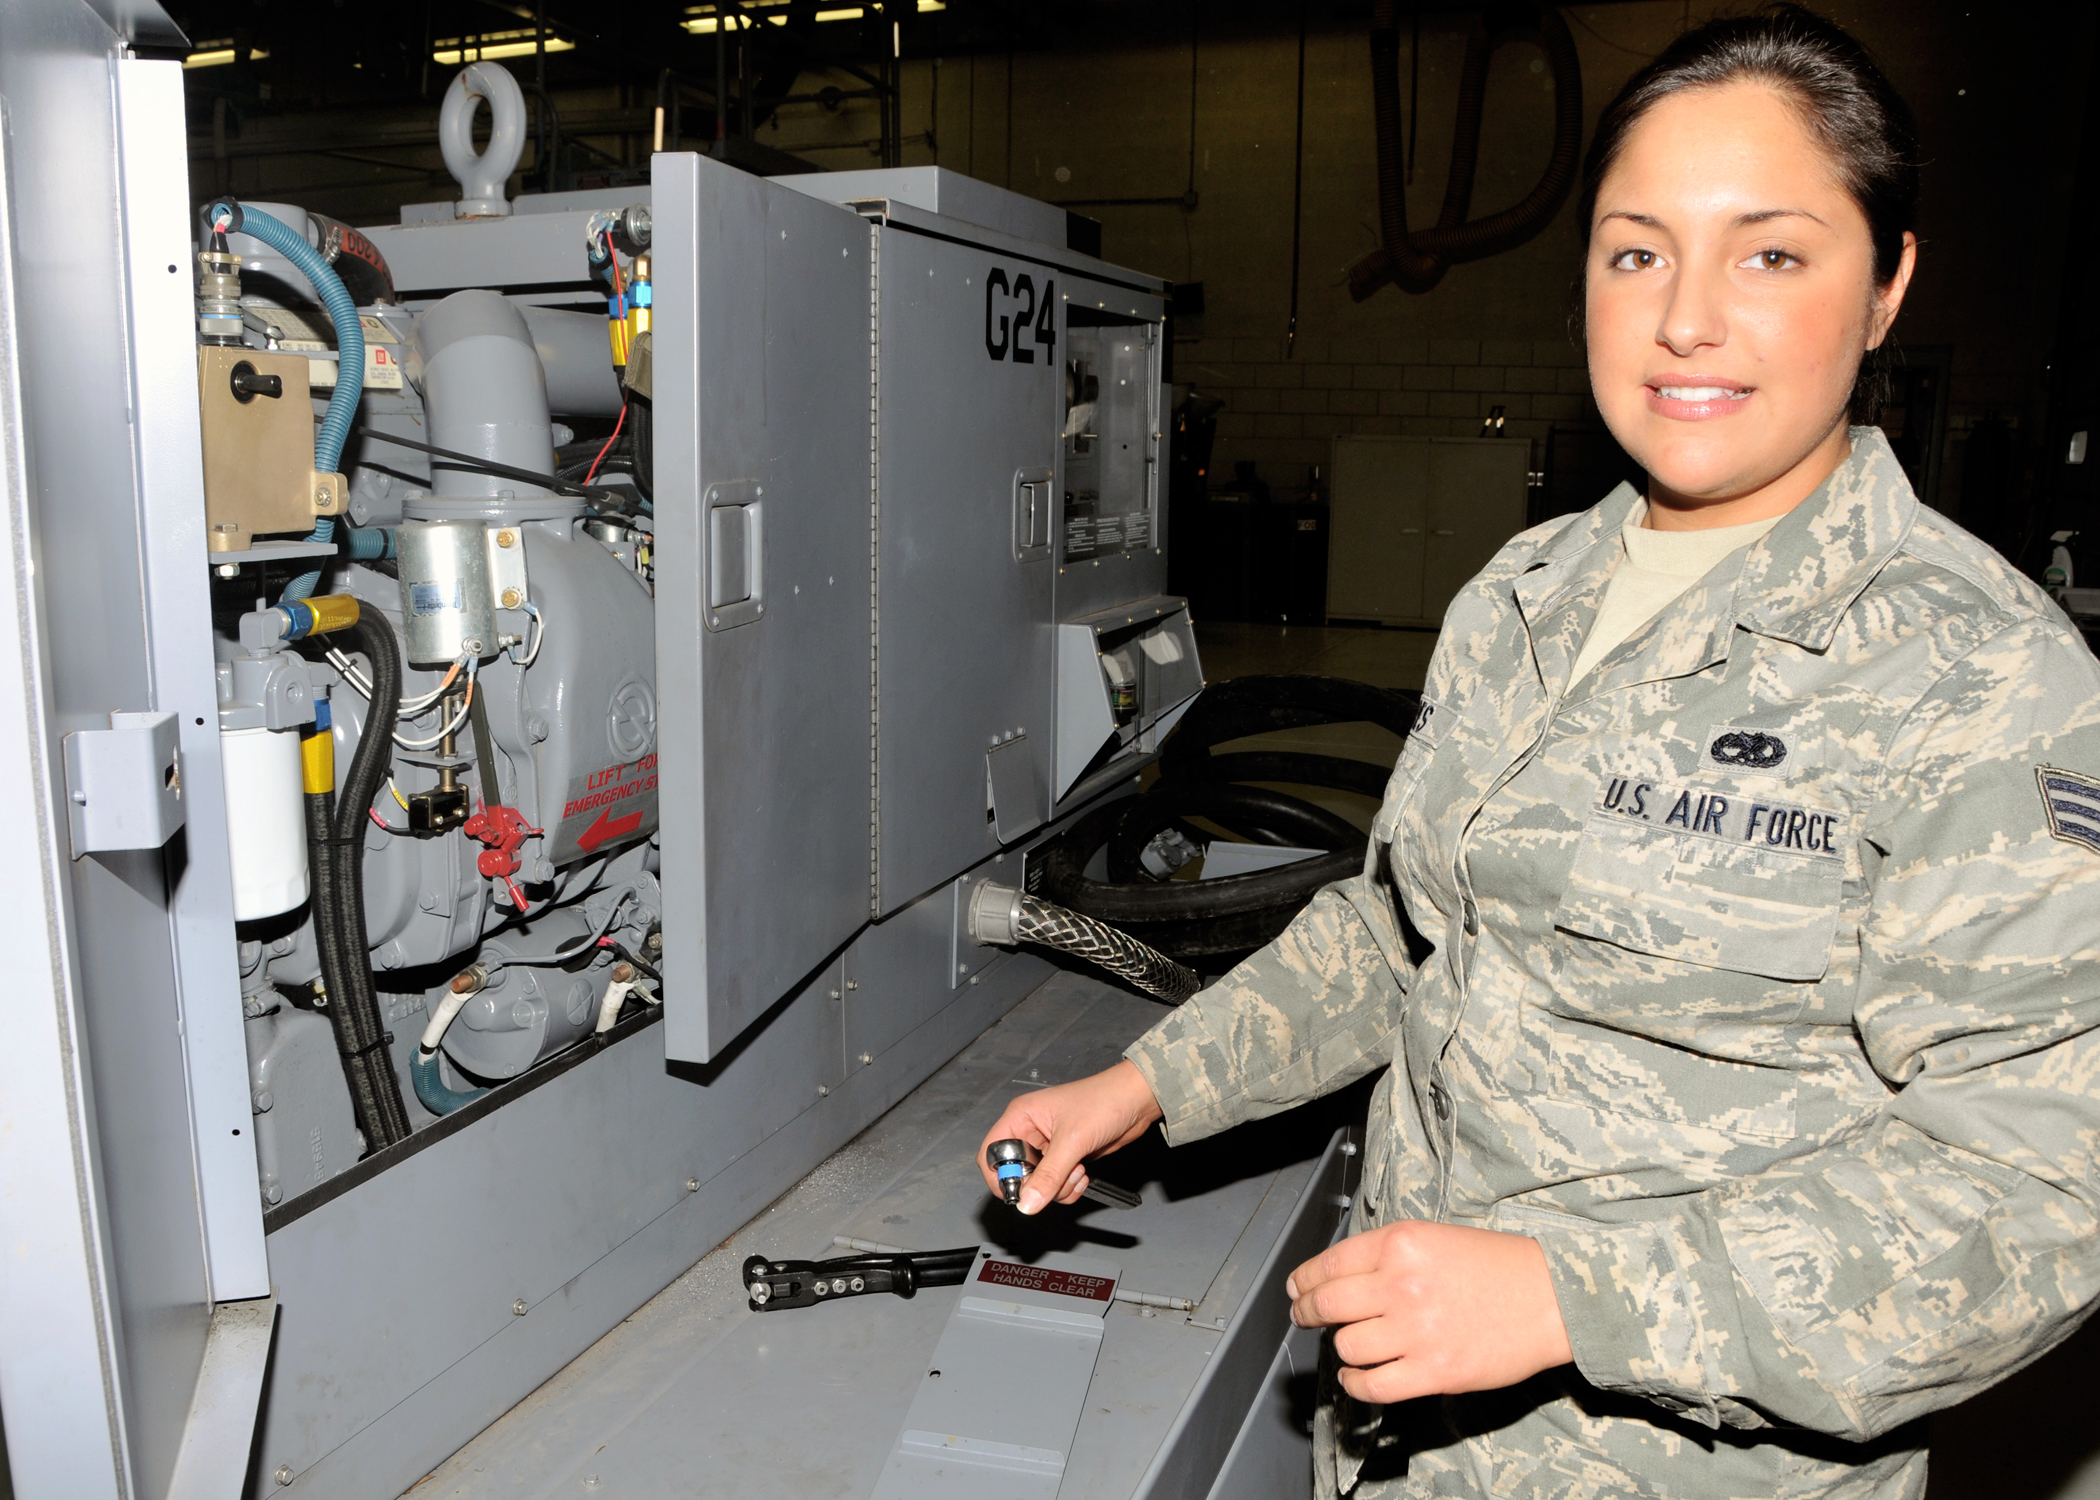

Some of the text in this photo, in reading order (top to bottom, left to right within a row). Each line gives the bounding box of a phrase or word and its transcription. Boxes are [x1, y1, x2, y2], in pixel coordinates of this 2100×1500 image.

[986, 267, 1056, 366] G24
[587, 765, 626, 791] LIFT
[563, 778, 645, 818] EMERGENCY
[1603, 779, 1839, 854] U.S. AIR FORCE
[991, 1263, 1050, 1280] DANGER
[1067, 1275, 1106, 1288] KEEP
[992, 1273, 1096, 1297] HANDS CLEAR
